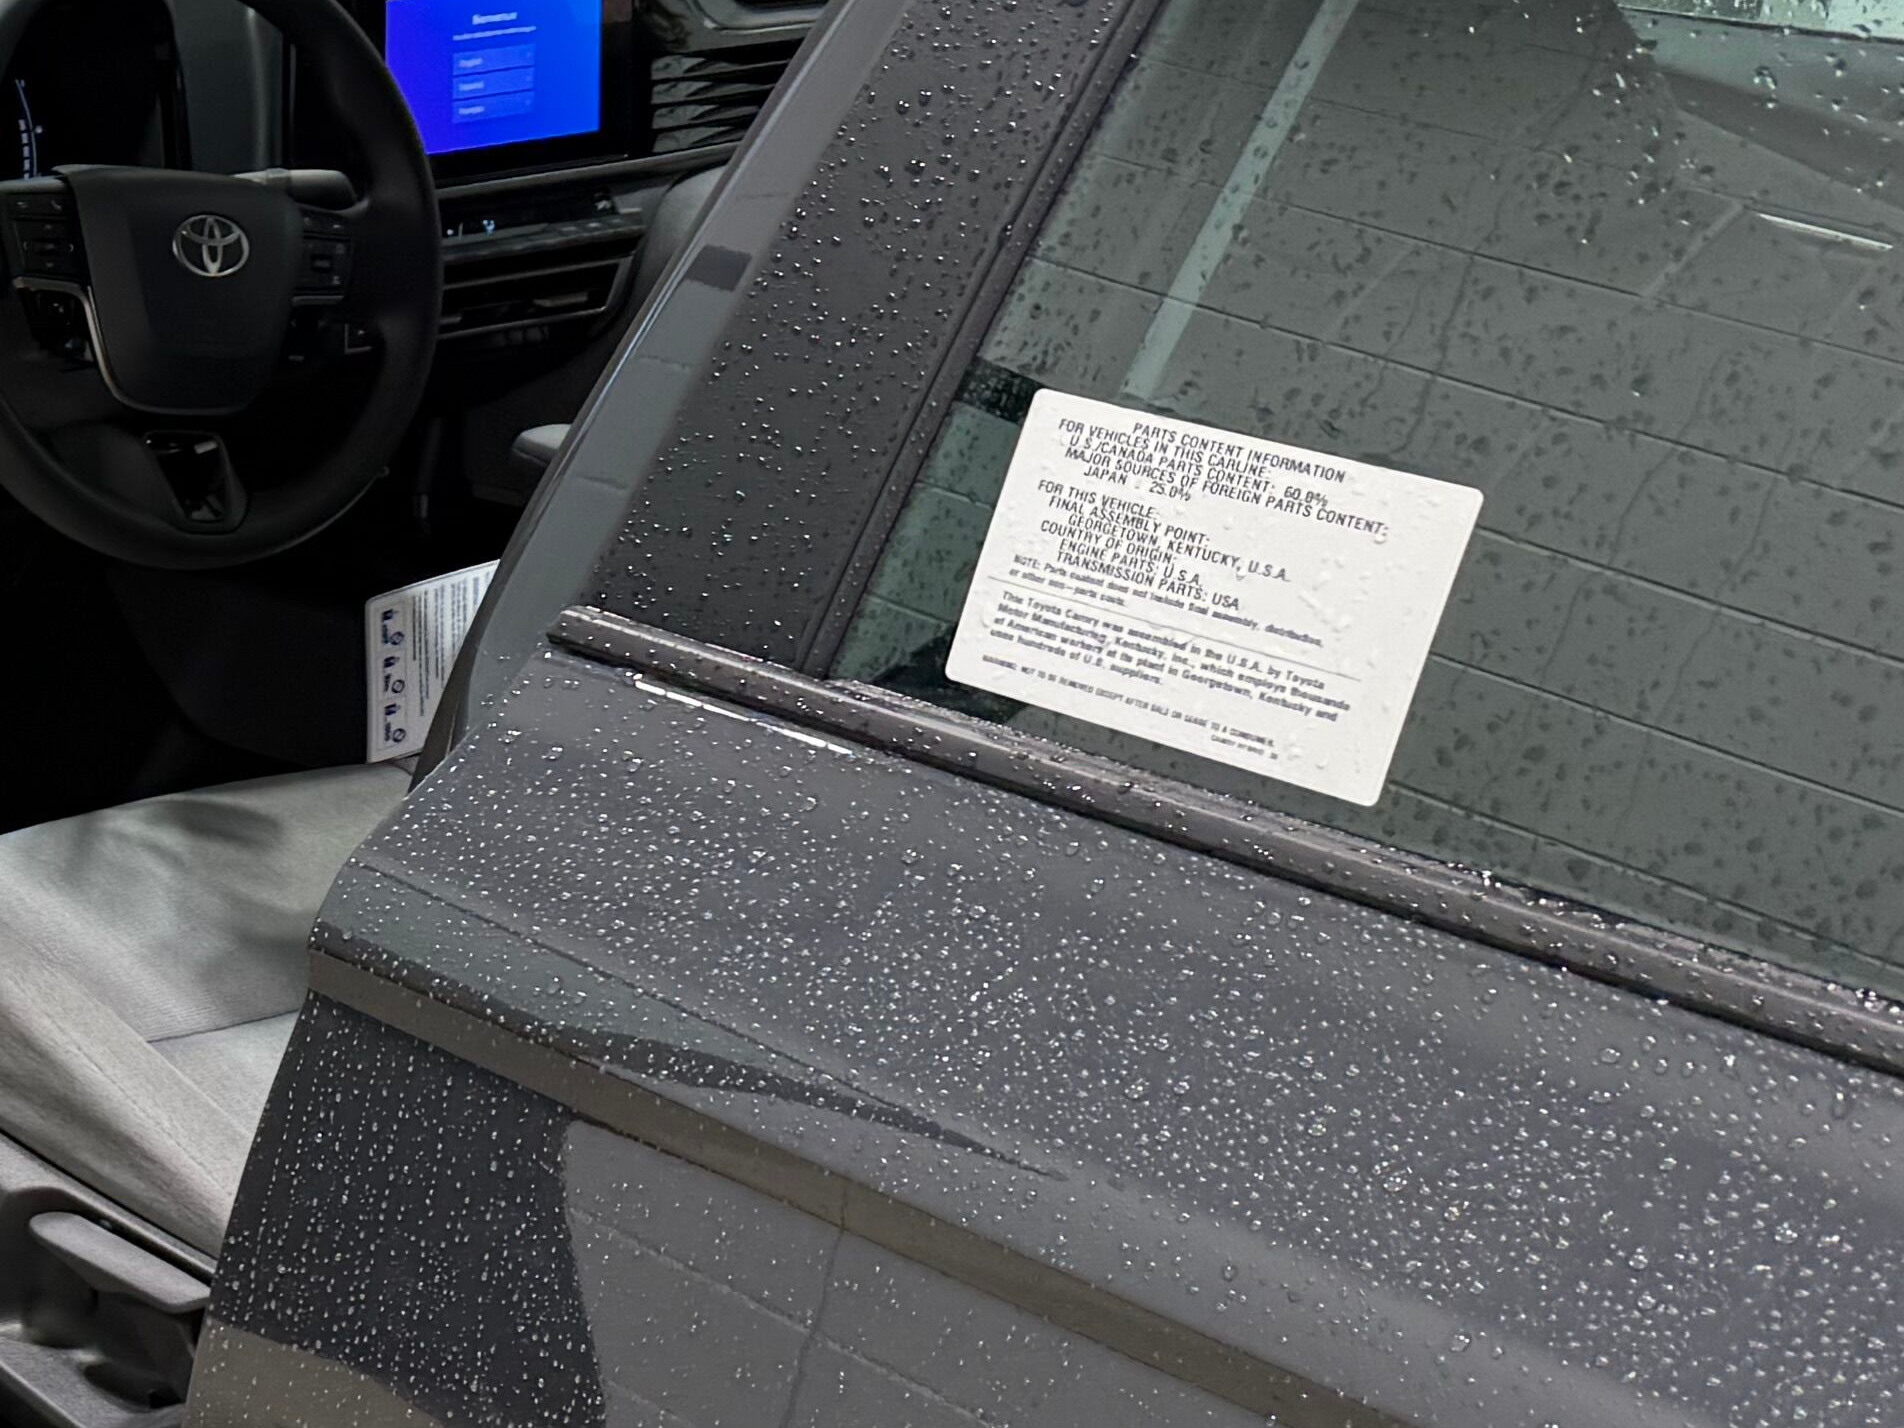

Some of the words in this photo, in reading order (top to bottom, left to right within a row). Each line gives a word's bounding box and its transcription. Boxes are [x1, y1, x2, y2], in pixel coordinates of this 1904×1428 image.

[1057, 417, 1085, 435] FOR
[1088, 424, 1150, 450] VEHICLES
[1152, 439, 1169, 455] IN
[1173, 444, 1204, 463] THIS
[1131, 421, 1177, 443] PARTS
[1179, 433, 1244, 458] CONTENT
[1246, 449, 1345, 482] INFORMATION
[1037, 478, 1064, 495] FOR
[1067, 485, 1097, 504] THIS
[1100, 494, 1159, 520] VEHICLE:
[1064, 445, 1111, 468] MAJOR
[1114, 458, 1176, 484] SOURCES
[1179, 473, 1199, 489] OF
[1201, 479, 1262, 504] FOREIGN
[1264, 494, 1313, 517] PARTS
[1315, 507, 1389, 536] CONTENT:
[1082, 464, 1128, 485] JAPAN
[1157, 455, 1203, 476] PARTS
[1206, 466, 1275, 494] CONTENT:
[1040, 519, 1102, 544] COUNTRY
[1104, 536, 1123, 550] OF
[1125, 541, 1177, 567] ORIGIN:
[1048, 494, 1084, 516] FINAL
[1088, 505, 1161, 533] ASSEMBLY
[1163, 524, 1210, 547] POINT:
[1067, 513, 1162, 551] GEORGETOWN,
[1166, 539, 1243, 571] KENTUCKY,
[1056, 550, 1154, 586] TRANSMISSION
[1157, 577, 1207, 602] PARTS:
[1210, 591, 1239, 611] USA
[1058, 537, 1108, 561] ENGINE
[1110, 551, 1159, 575] PARTS:
[1027, 596, 1062, 616] Toyota
[1064, 608, 1099, 627] Camry
[1285, 669, 1325, 690] Toyota
